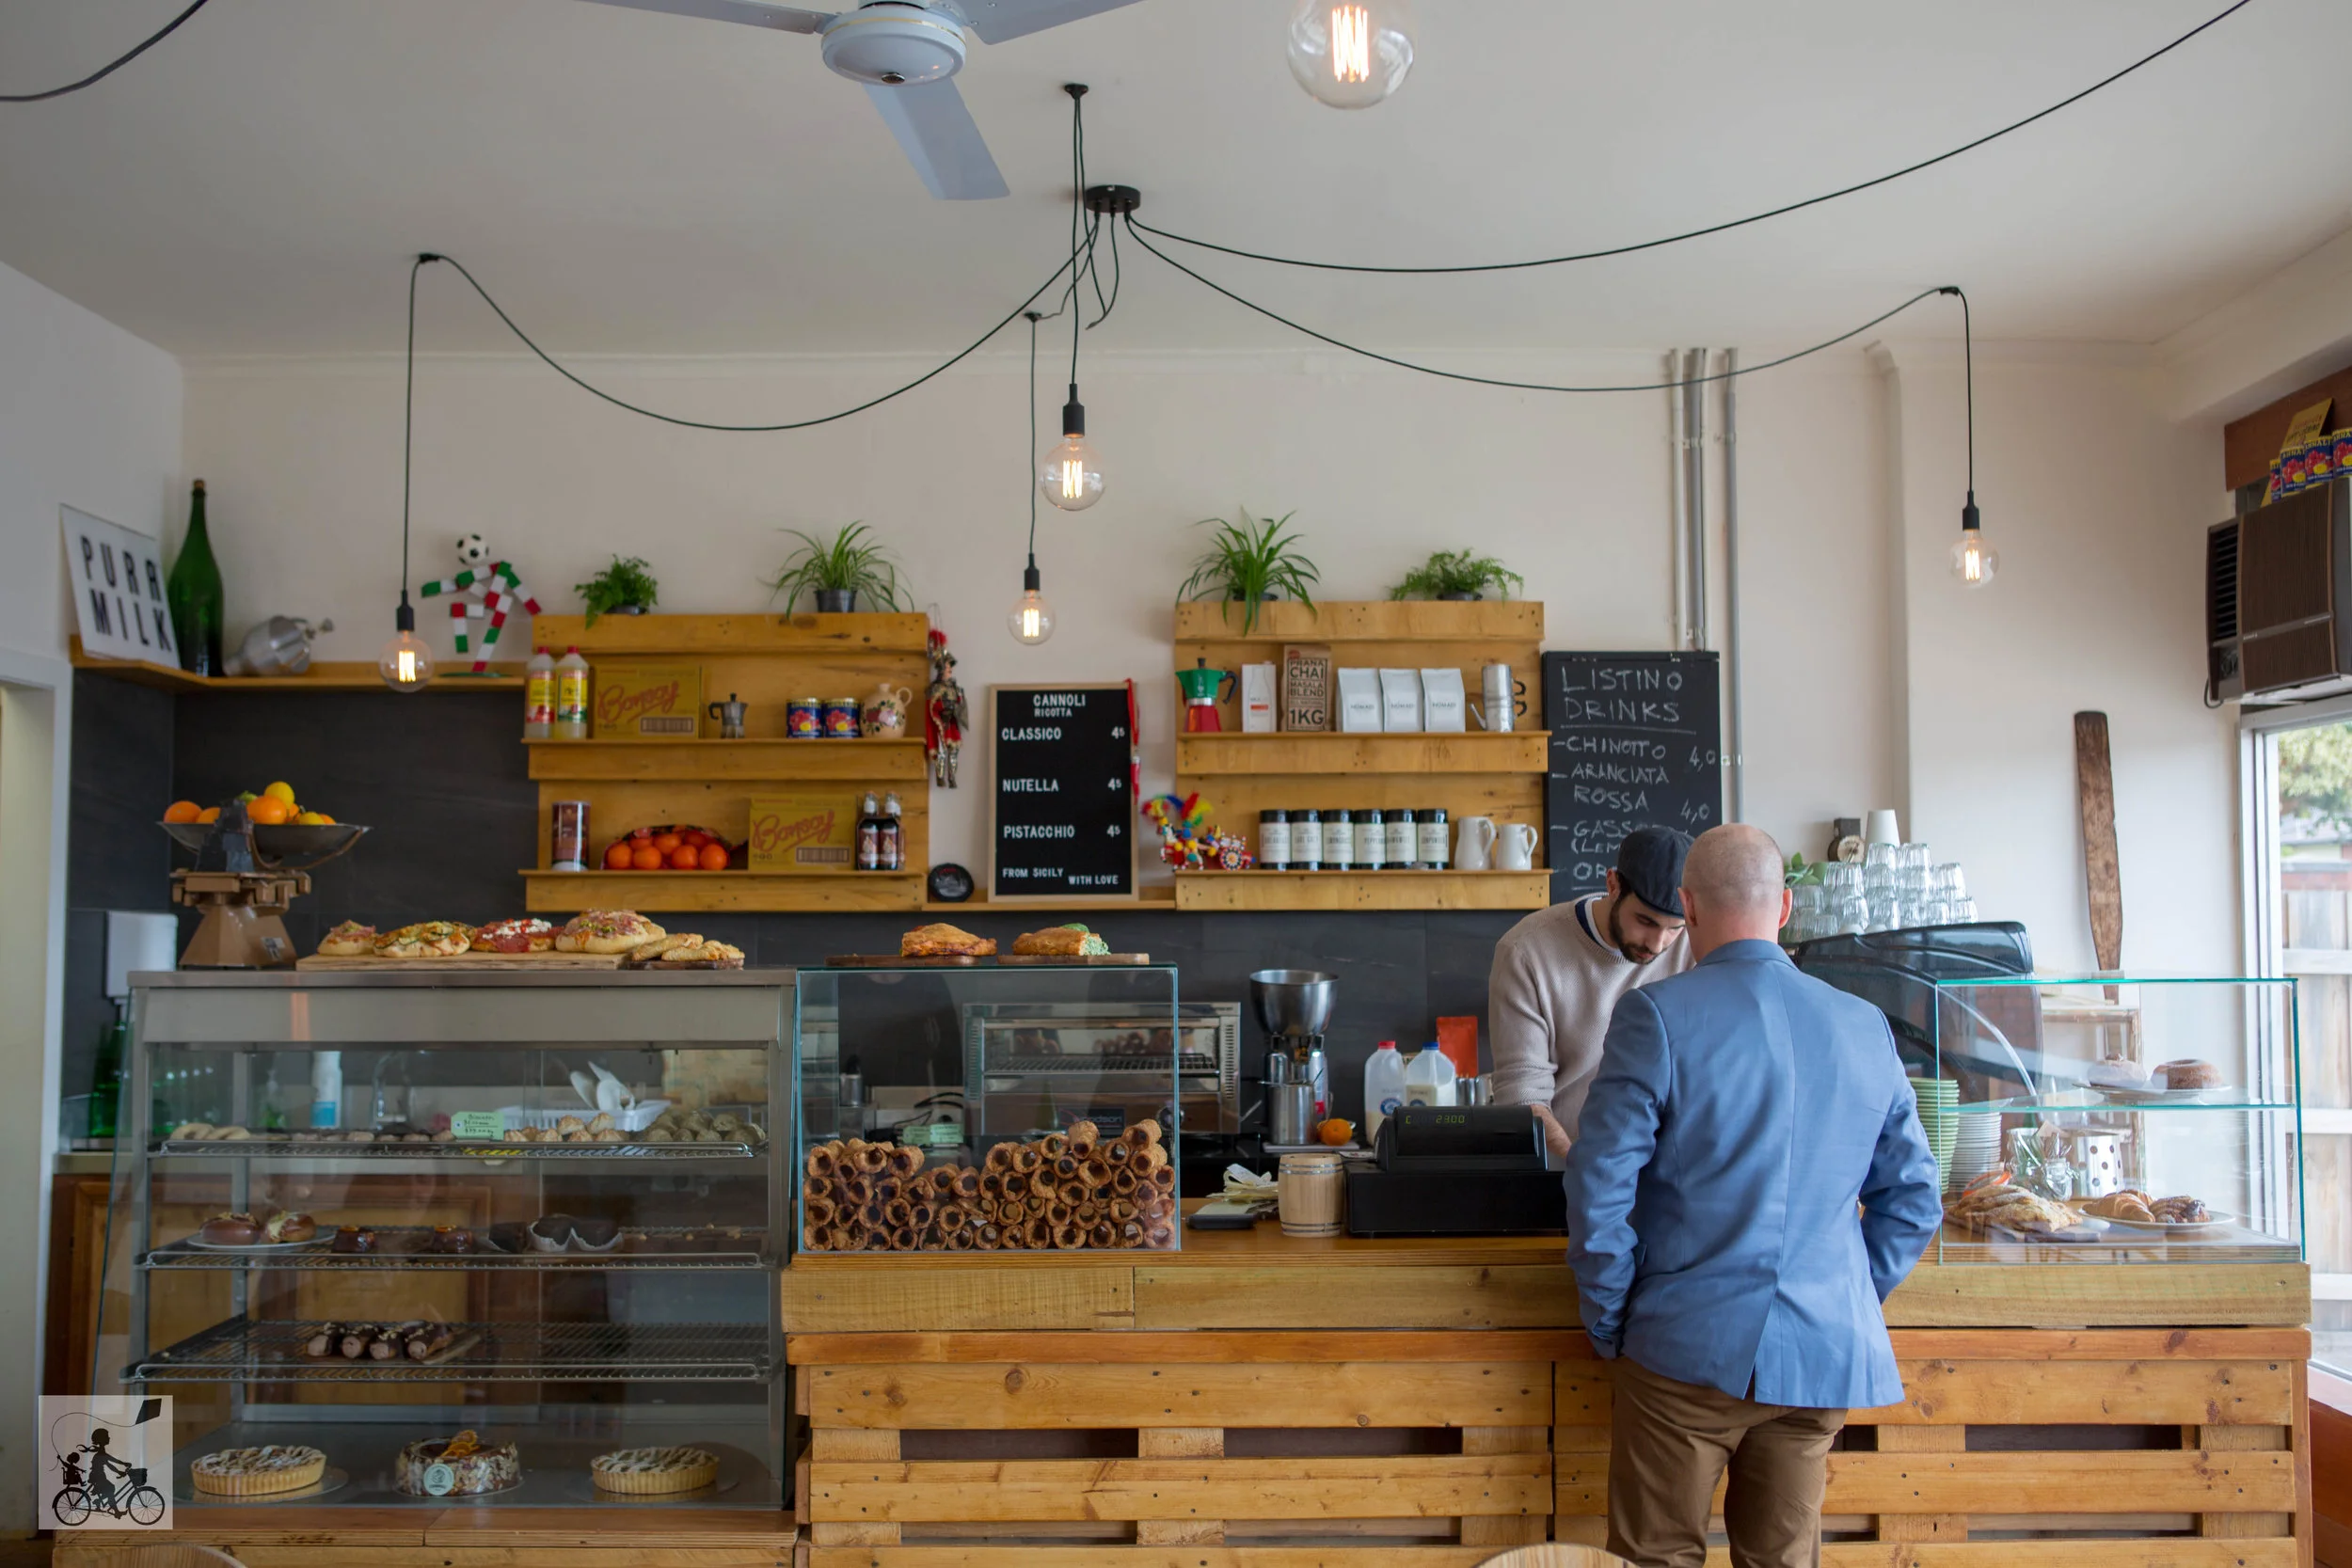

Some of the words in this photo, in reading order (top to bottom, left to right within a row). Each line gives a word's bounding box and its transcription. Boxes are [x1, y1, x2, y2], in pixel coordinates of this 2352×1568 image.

[80, 535, 161, 602] PURA
[89, 588, 172, 652] MILK
[1290, 667, 1324, 679] CHAI
[1562, 665, 1683, 693] LISTINO
[1291, 688, 1324, 697] BLEND
[1033, 694, 1086, 707] CANNOLI
[1034, 707, 1073, 717] RICOTTA
[1290, 708, 1325, 725] 1KG
[1564, 697, 1680, 722] DRINKS
[1001, 727, 1062, 741] CLASSICO
[1570, 763, 1670, 784] ARANCIATA
[1002, 779, 1059, 792] NUTELLA
[1573, 784, 1649, 812] ROSSA
[1003, 825, 1075, 839] PISTACCHIO
[1570, 837, 1621, 855] (LEM
[1002, 868, 1028, 879] FROM
[1032, 867, 1064, 878] SICILY
[1068, 875, 1092, 885] WITH
[1094, 875, 1119, 885] LOVE
